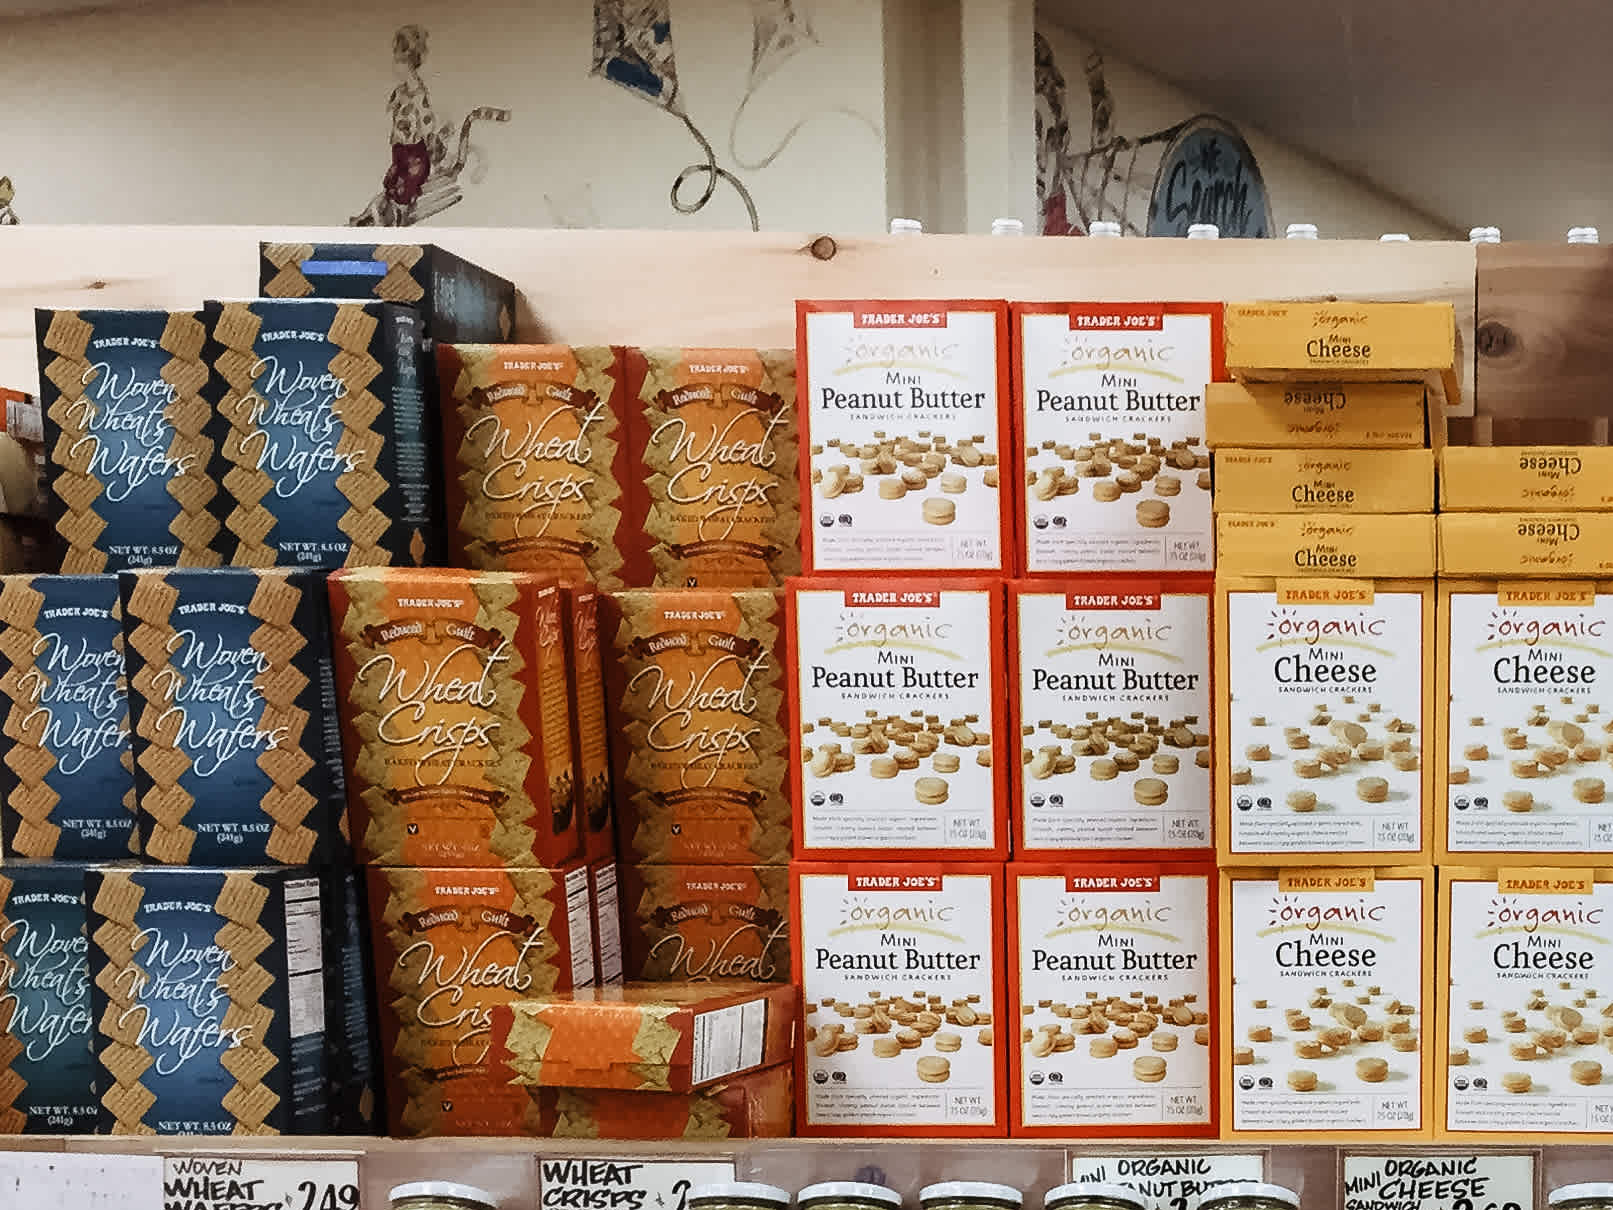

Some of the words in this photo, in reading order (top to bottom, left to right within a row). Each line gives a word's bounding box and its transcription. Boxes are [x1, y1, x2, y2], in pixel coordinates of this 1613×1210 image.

[251, 355, 348, 400] Woven
[822, 388, 903, 409] Peanut
[910, 388, 986, 409] Butter
[241, 430, 366, 500] Wafers
[852, 592, 897, 603] TRADER
[900, 593, 934, 603] JOE'S
[1285, 590, 1330, 600] TRADER
[1333, 590, 1366, 600] JOE'S
[848, 617, 952, 645] organic
[1278, 614, 1386, 644] organic
[359, 639, 509, 709] Wheat
[812, 667, 896, 689] Peanut
[903, 667, 978, 689] Butter
[1274, 656, 1376, 683] Cheese
[376, 701, 502, 786] Crisps
[173, 1160, 244, 1176] WOVEN
[543, 1162, 643, 1186] WHEAT
[1118, 1159, 1212, 1176] ORGANIC
[1384, 1156, 1478, 1178] ORGANIC
[164, 1179, 264, 1200] WHEAT
[1346, 1171, 1381, 1195] MINI
[1379, 1176, 1490, 1200] CHEESE
[545, 1187, 646, 1210] CRISPS
